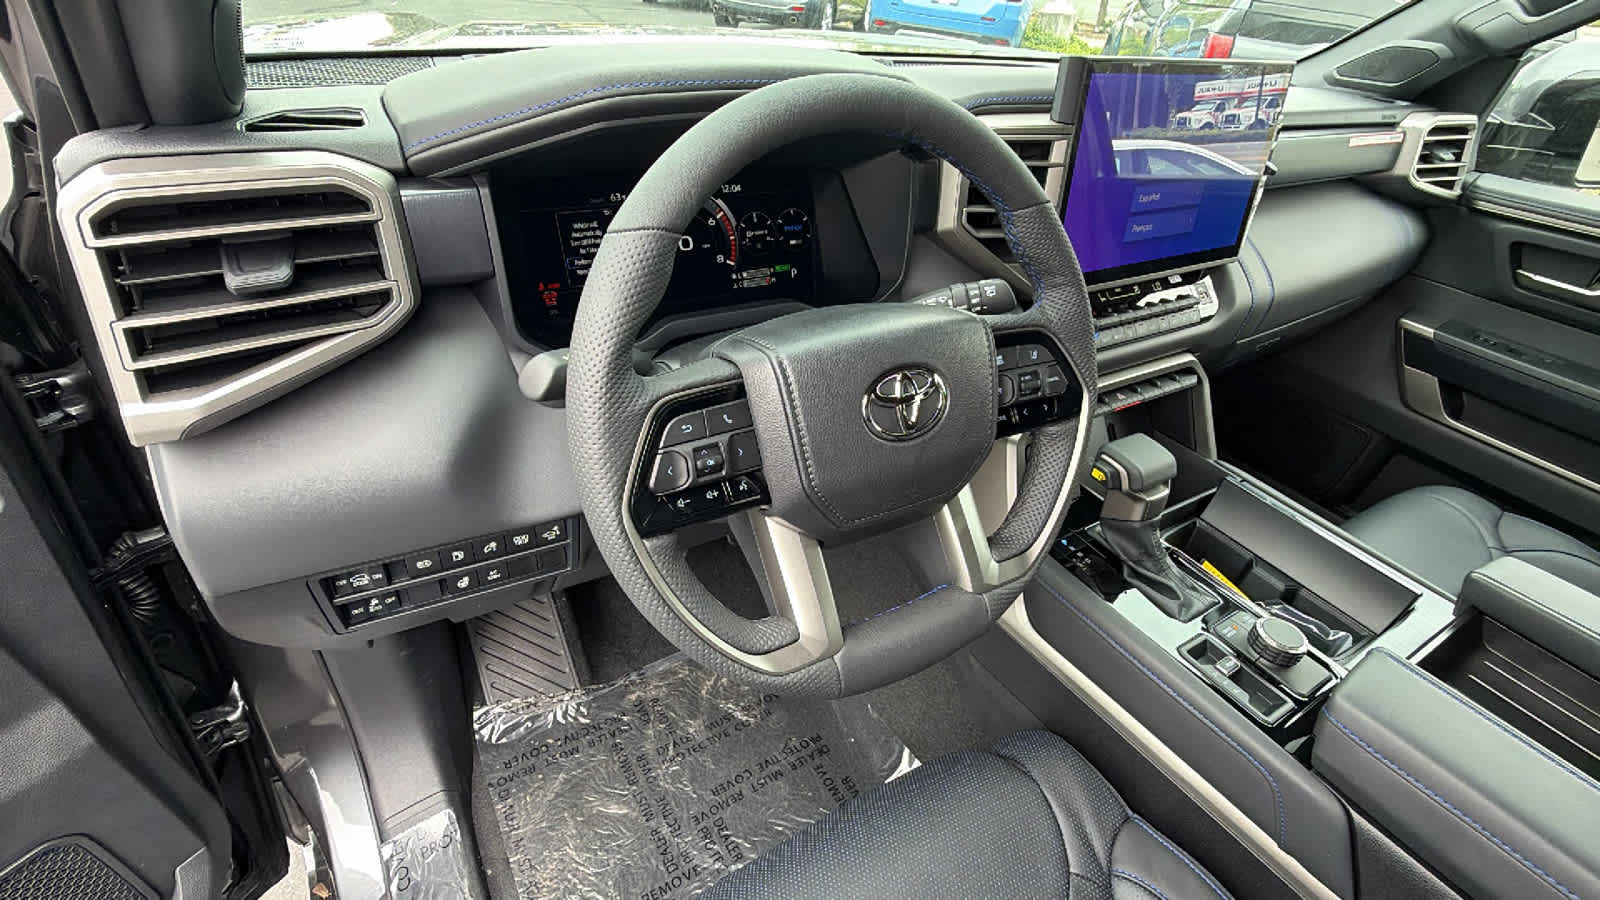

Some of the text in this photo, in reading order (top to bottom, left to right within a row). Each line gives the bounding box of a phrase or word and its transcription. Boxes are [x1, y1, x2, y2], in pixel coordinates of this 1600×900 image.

[503, 744, 549, 770] COVER
[711, 769, 753, 797] COVER
[750, 769, 785, 794] MUST
[691, 790, 744, 826] REMOVE
[713, 816, 743, 862] DEALER
